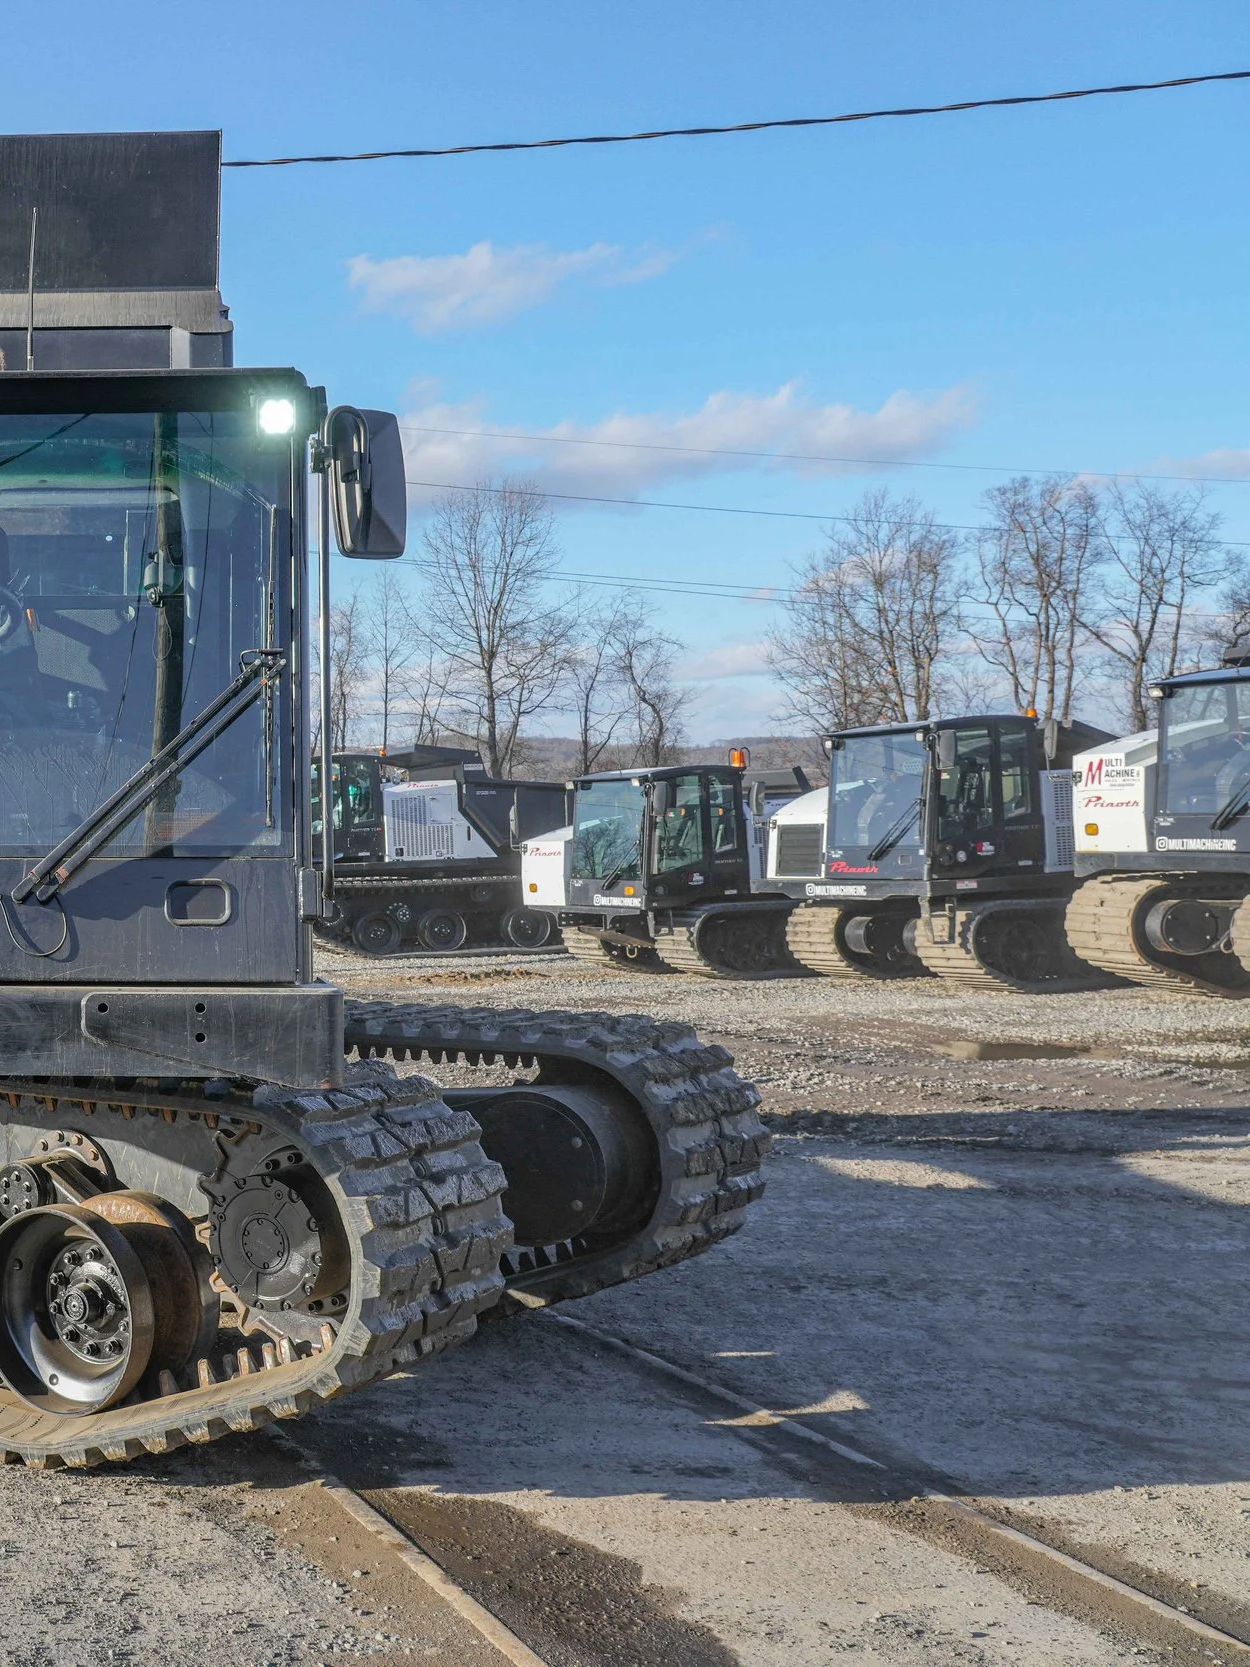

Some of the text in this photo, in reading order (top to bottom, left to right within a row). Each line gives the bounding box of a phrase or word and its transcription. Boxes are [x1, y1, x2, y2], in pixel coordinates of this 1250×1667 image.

[1082, 796, 1140, 807] Prinoth
[1168, 838, 1237, 851] MULTIMACHINEINC
[529, 847, 562, 857] Prinoth
[829, 861, 879, 873] Prinoth
